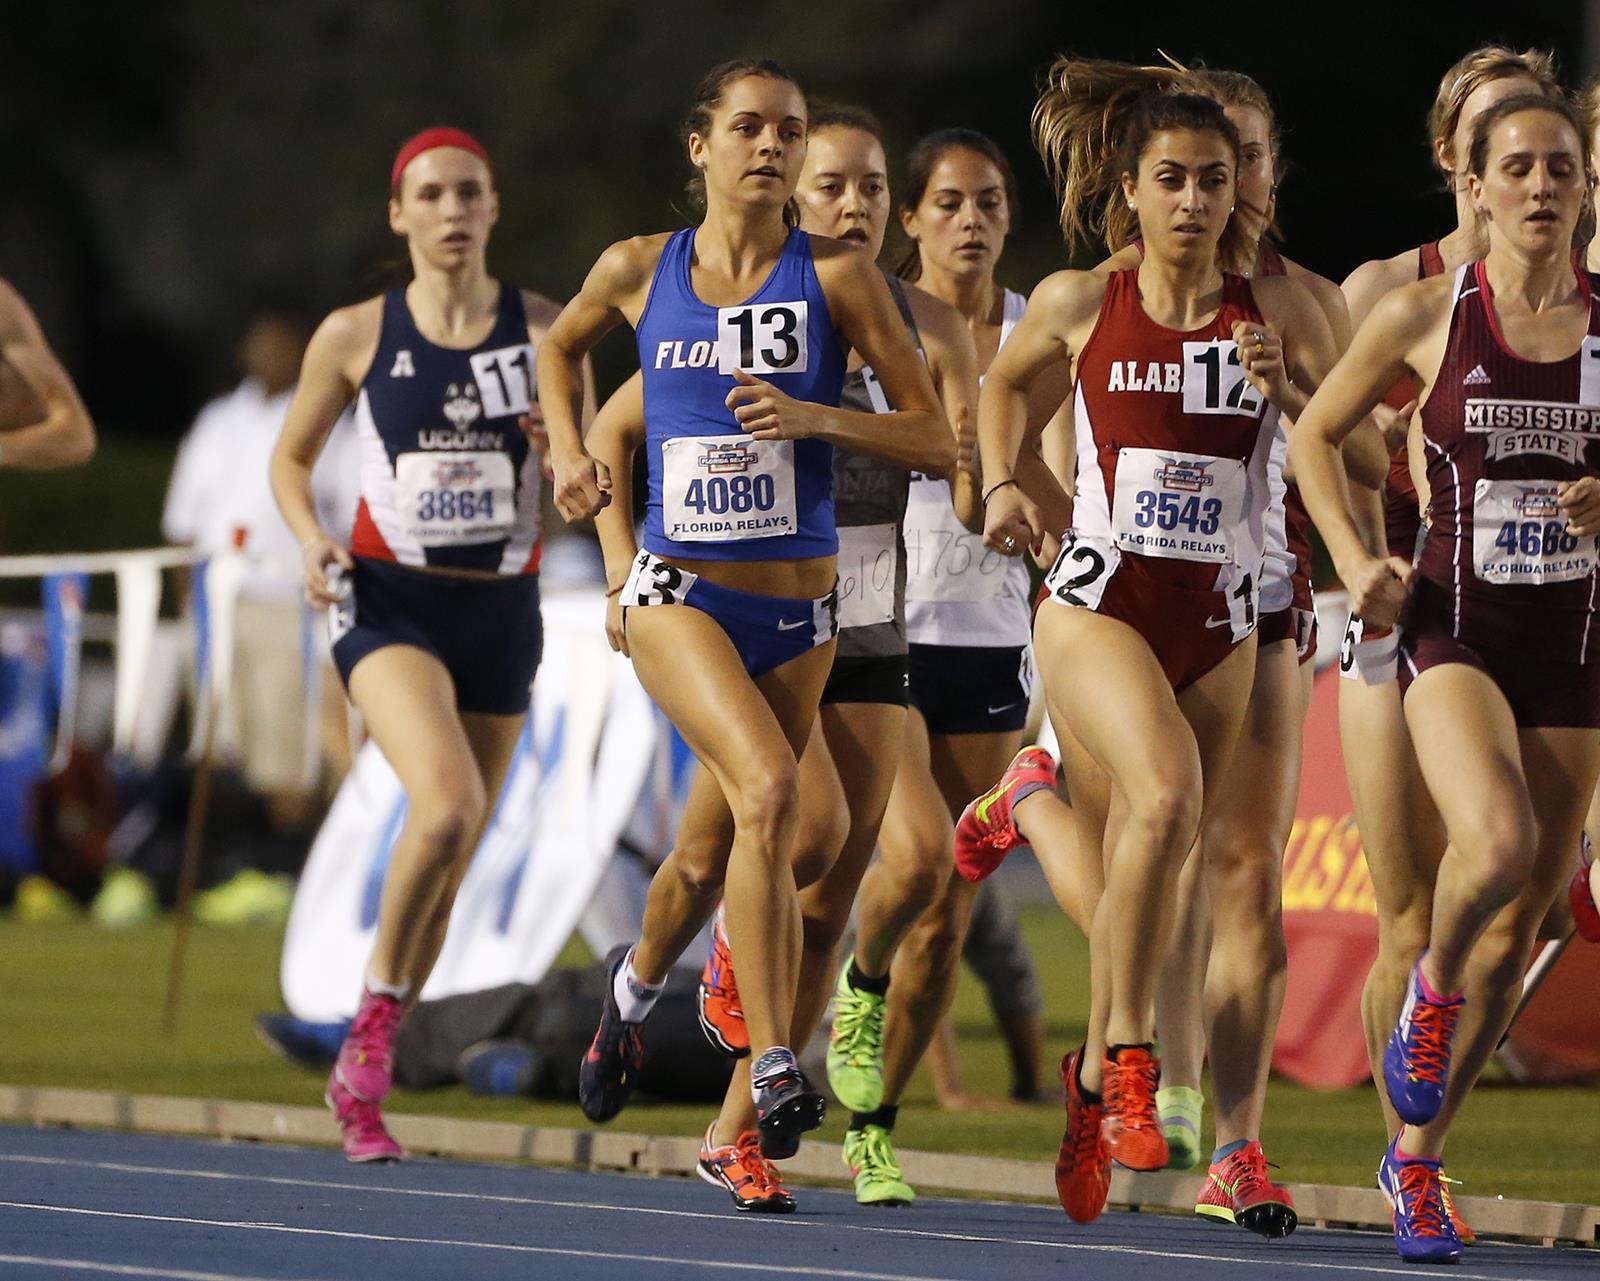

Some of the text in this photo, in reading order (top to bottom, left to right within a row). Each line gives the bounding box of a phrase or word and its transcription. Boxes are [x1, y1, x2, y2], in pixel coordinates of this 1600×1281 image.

[728, 307, 799, 368] 13
[389, 350, 416, 378] A
[484, 351, 532, 408] 11
[1107, 361, 1183, 393] ALAB
[1193, 347, 1257, 411] 12
[1504, 434, 1570, 456] STATE
[418, 490, 494, 520] 3864
[684, 474, 775, 515] 4080
[674, 516, 789, 533] FLORIDA RELAYS
[1135, 490, 1222, 535] 3543
[1121, 533, 1226, 554] FLORIDA RELAYS
[1483, 558, 1589, 574] FLORIDA RELAYS
